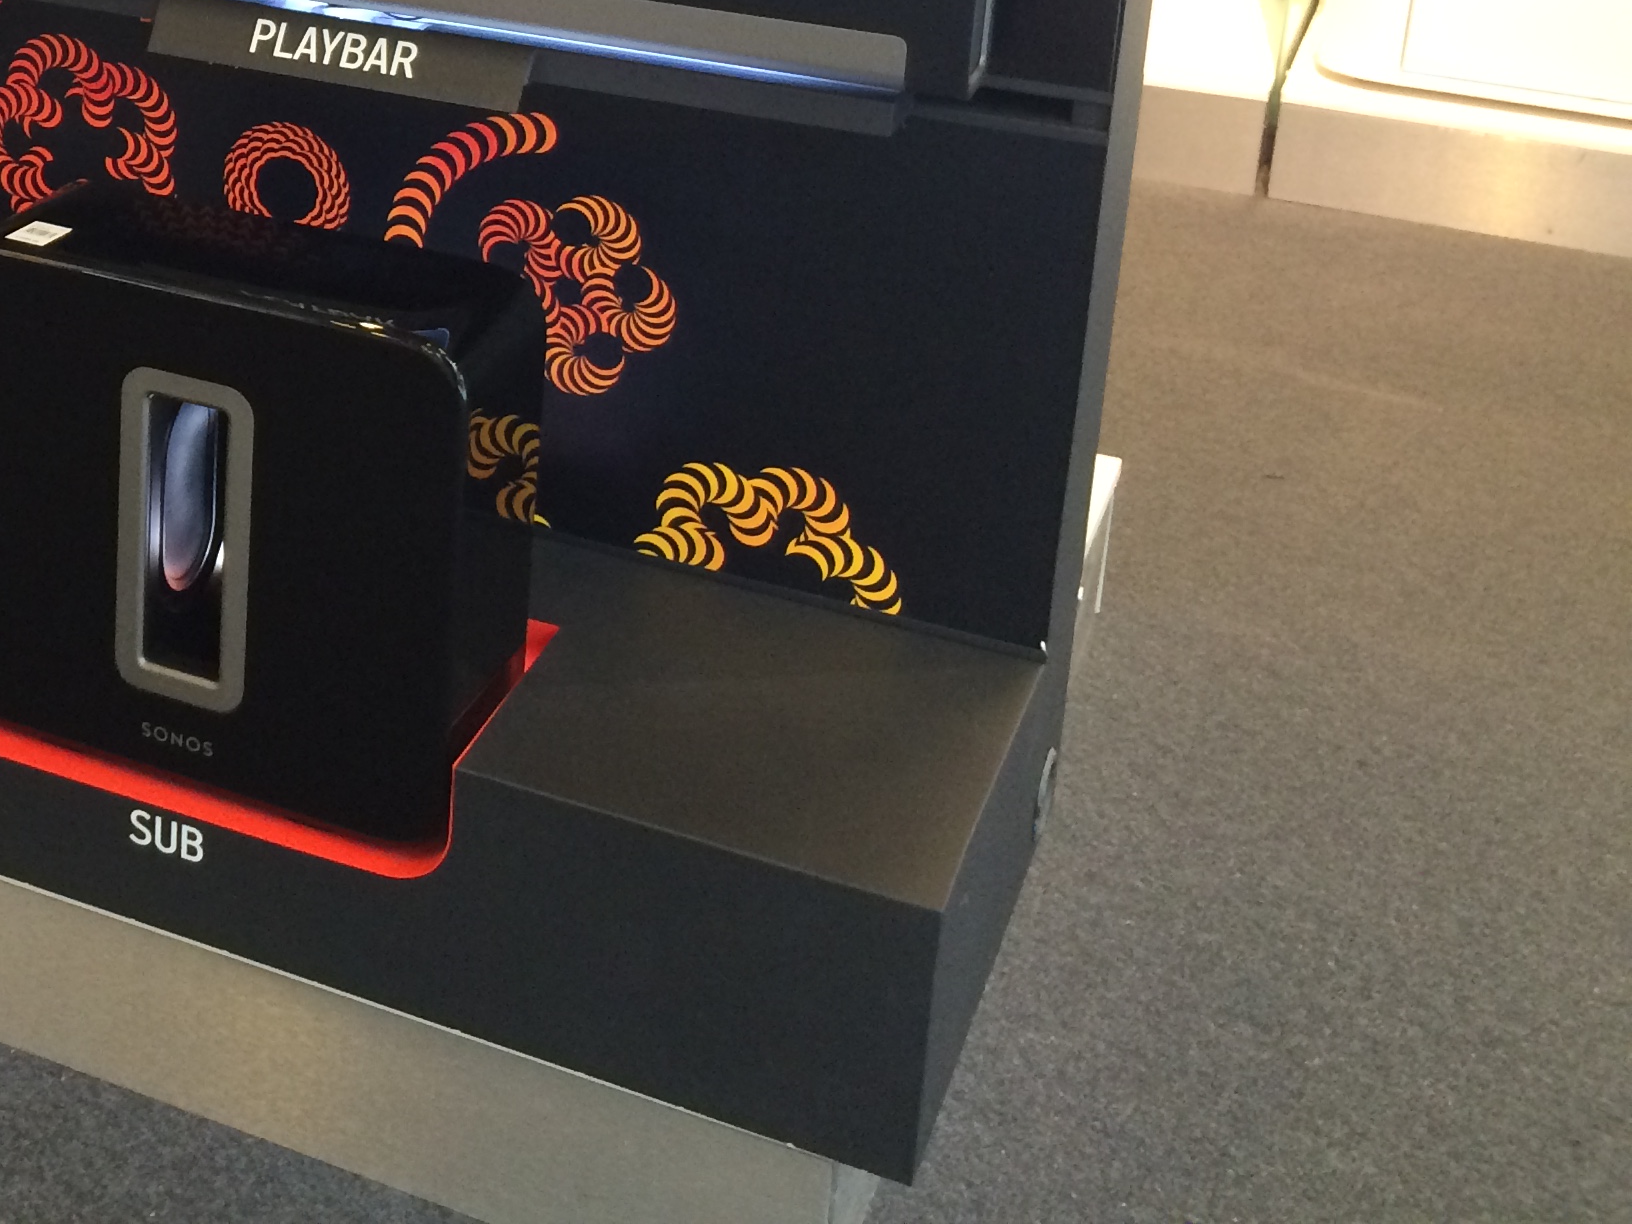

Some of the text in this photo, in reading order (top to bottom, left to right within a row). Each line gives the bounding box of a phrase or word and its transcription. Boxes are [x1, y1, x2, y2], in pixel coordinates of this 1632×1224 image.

[248, 17, 419, 80] PLAYBAR
[141, 721, 214, 758] SONOS
[128, 808, 205, 863] SUB
